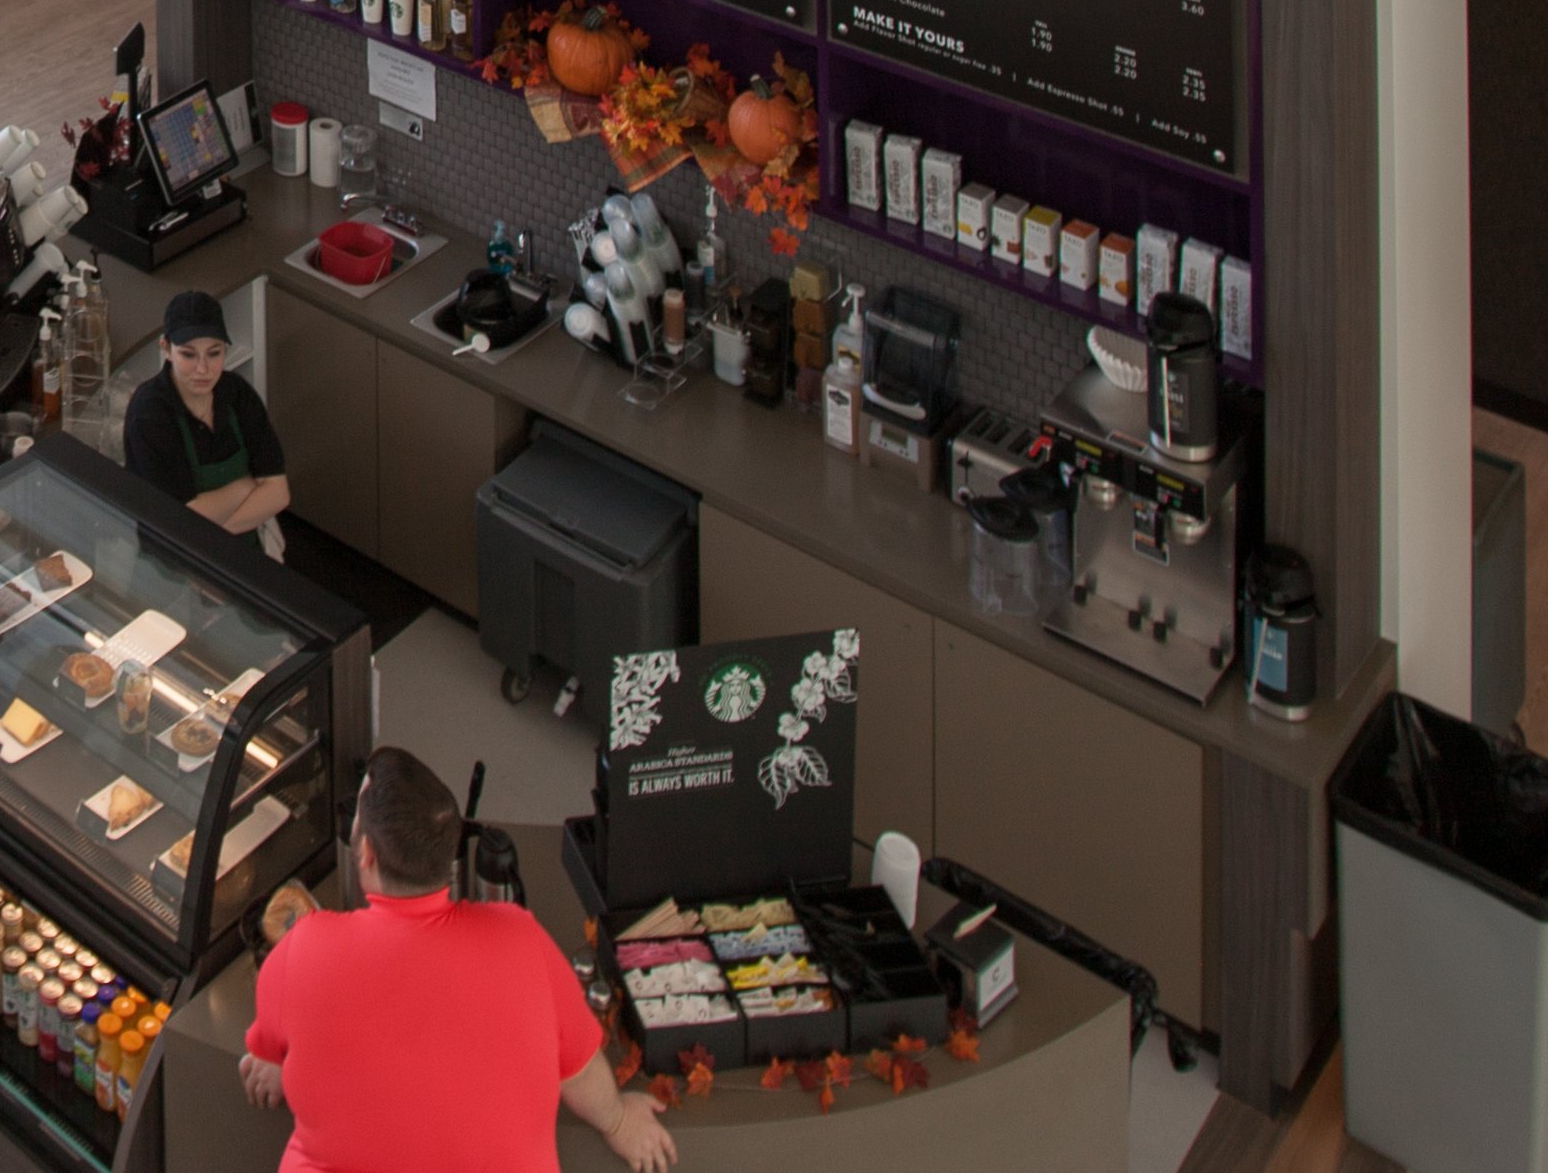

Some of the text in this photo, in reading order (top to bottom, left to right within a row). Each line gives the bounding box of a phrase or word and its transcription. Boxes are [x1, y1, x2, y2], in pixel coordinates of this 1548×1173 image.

[1181, 0, 1205, 16] 3.60
[853, 6, 964, 53] MAKE IT YOURS
[1031, 26, 1052, 41] 1.90
[853, 19, 870, 31] Add
[871, 24, 896, 39] Flavor
[897, 33, 916, 46] Shot
[917, 42, 942, 54] regular
[951, 54, 971, 64] sugar
[1114, 53, 1137, 68] 2.20
[1114, 64, 1137, 79] 2.20
[1027, 77, 1108, 111] Add Espresso Shot
[1151, 118, 1190, 139] Add Soy
[629, 768, 735, 796] IS ALWAYS WORTH IT.
